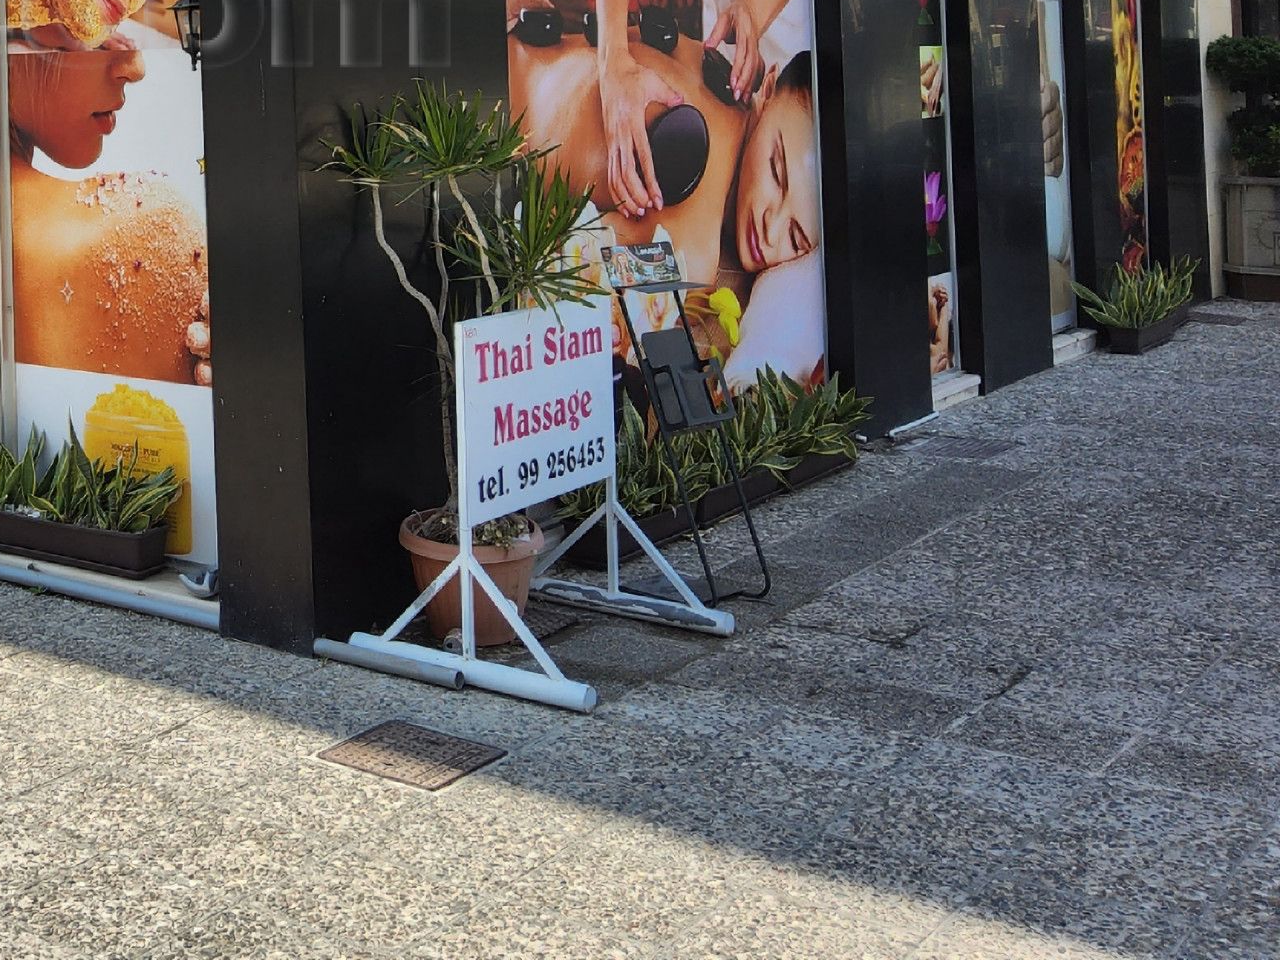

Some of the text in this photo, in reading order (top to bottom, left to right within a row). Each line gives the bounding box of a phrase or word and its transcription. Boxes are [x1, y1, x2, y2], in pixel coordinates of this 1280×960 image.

[475, 326, 603, 383] Thai Siam
[494, 389, 593, 447] Massage
[478, 436, 605, 503] tel. 99 256453
